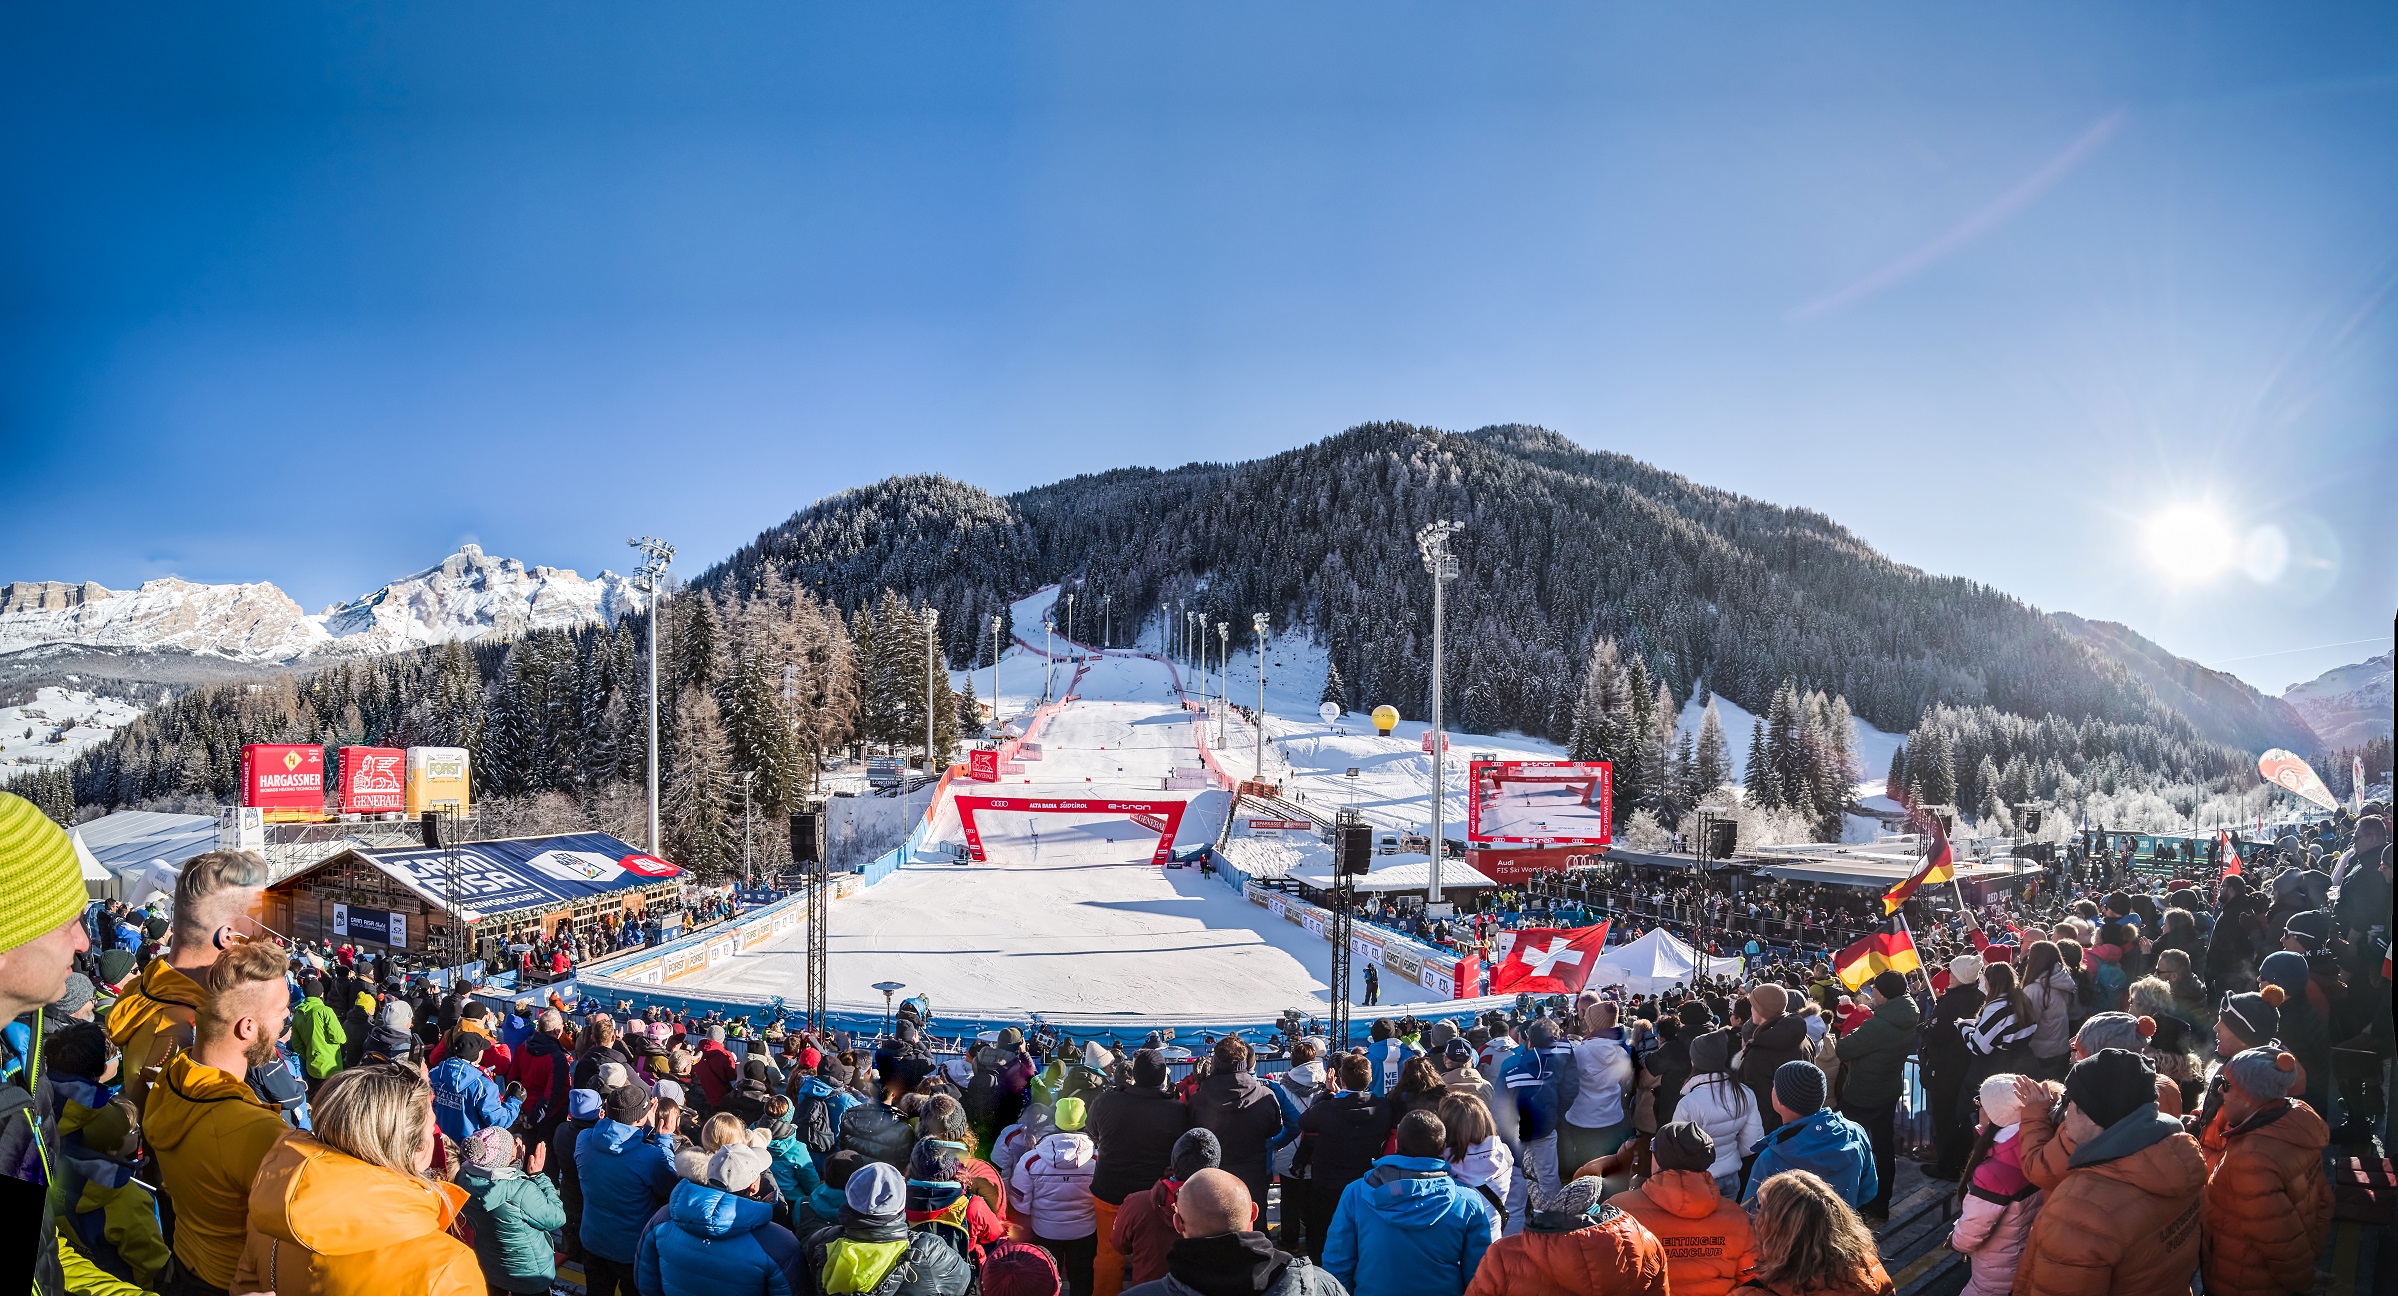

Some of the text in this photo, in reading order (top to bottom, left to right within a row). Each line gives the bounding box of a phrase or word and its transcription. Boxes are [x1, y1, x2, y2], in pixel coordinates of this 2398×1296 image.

[429, 762, 461, 776] FORST
[259, 773, 321, 788] HARGASSNER
[353, 794, 400, 808] GENERALI
[462, 892, 546, 911] SKIWORLDCUP.IT
[1987, 891, 1998, 904] RED
[690, 952, 704, 966] FORST
[1386, 952, 1400, 964] FORST
[669, 960, 685, 973] FORST
[1403, 958, 1419, 974] FORST
[1385, 1071, 1397, 1079] VE
[1662, 1236, 1726, 1247] EITINGER
[1664, 1247, 1723, 1258] FANCLUB
